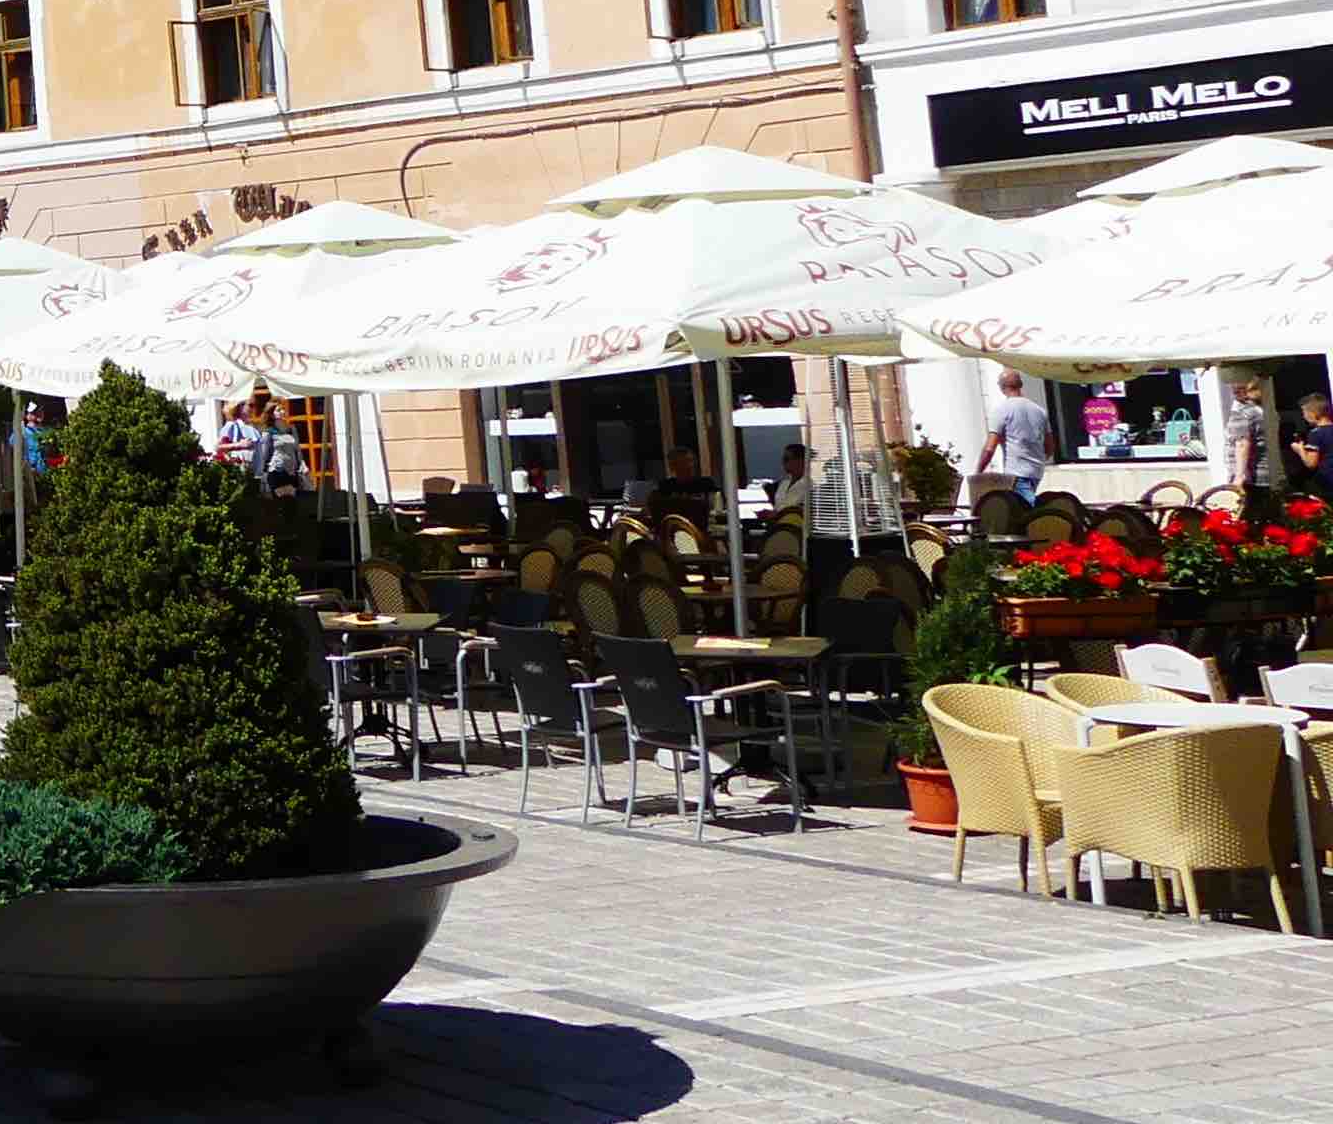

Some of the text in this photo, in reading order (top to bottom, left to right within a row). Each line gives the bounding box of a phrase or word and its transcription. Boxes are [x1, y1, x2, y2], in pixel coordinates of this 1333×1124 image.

[1021, 75, 1292, 125] MELI MELO
[1125, 109, 1179, 125] PARIS
[718, 308, 833, 347] URSUS
[227, 340, 311, 377] URSUS
